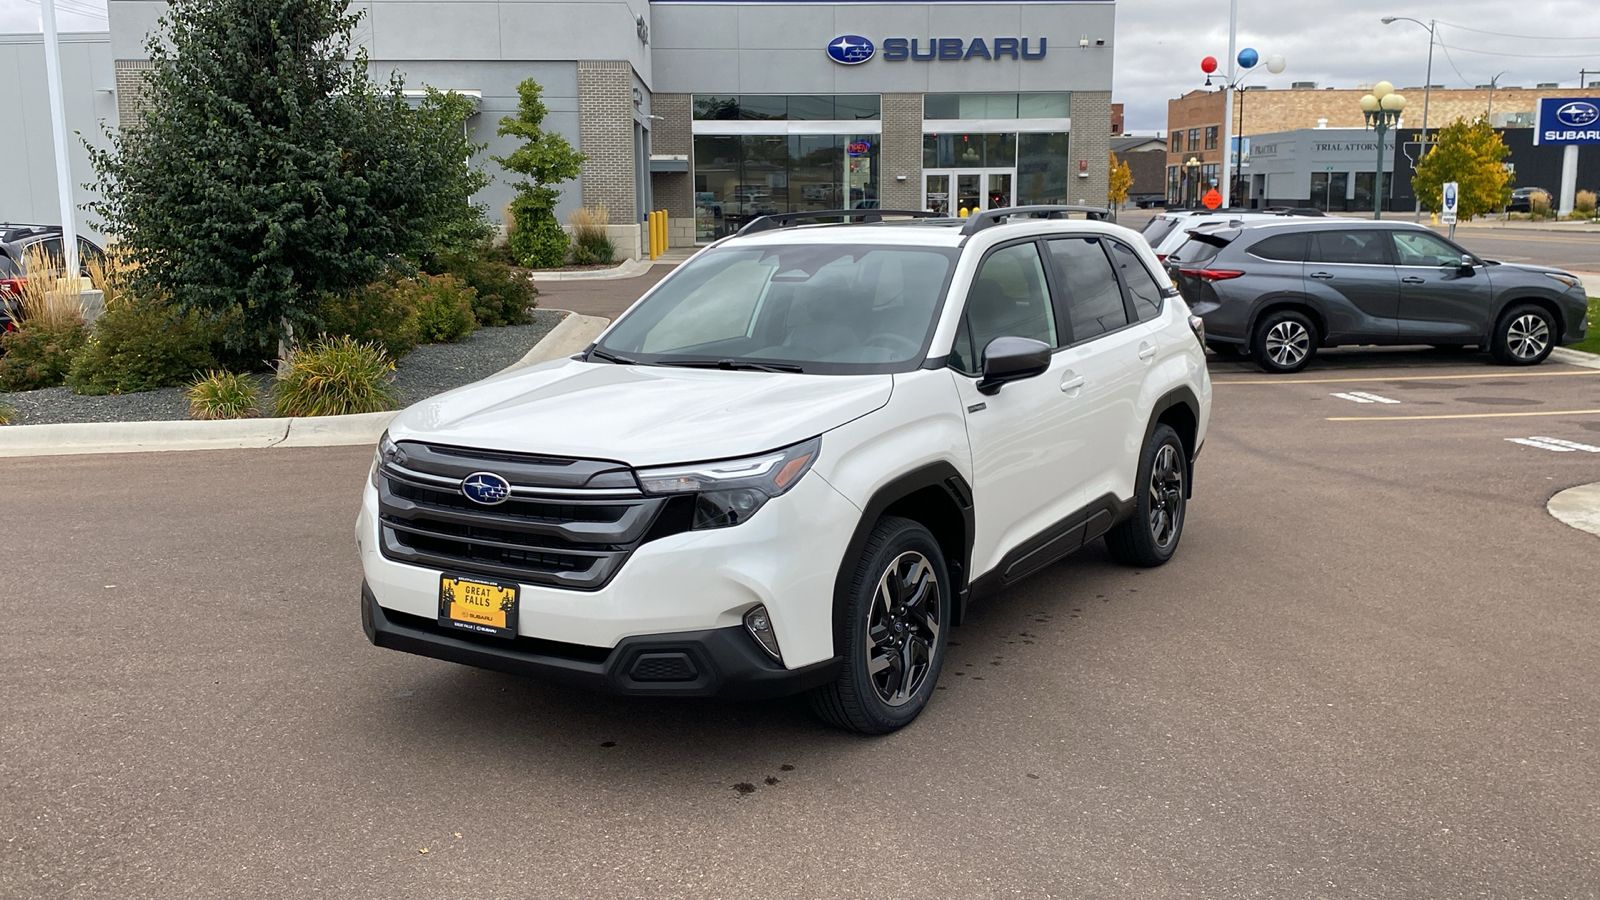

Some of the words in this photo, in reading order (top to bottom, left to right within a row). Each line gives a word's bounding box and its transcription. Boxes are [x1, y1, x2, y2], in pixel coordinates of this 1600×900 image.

[883, 37, 1047, 61] SUBARU
[847, 143, 867, 153] OPEN
[1316, 143, 1342, 151] TRIAL
[1344, 143, 1395, 151] ATTORNYS
[465, 585, 491, 597] GREAT
[464, 595, 490, 607] FALLS
[469, 612, 493, 621] SUBARU
